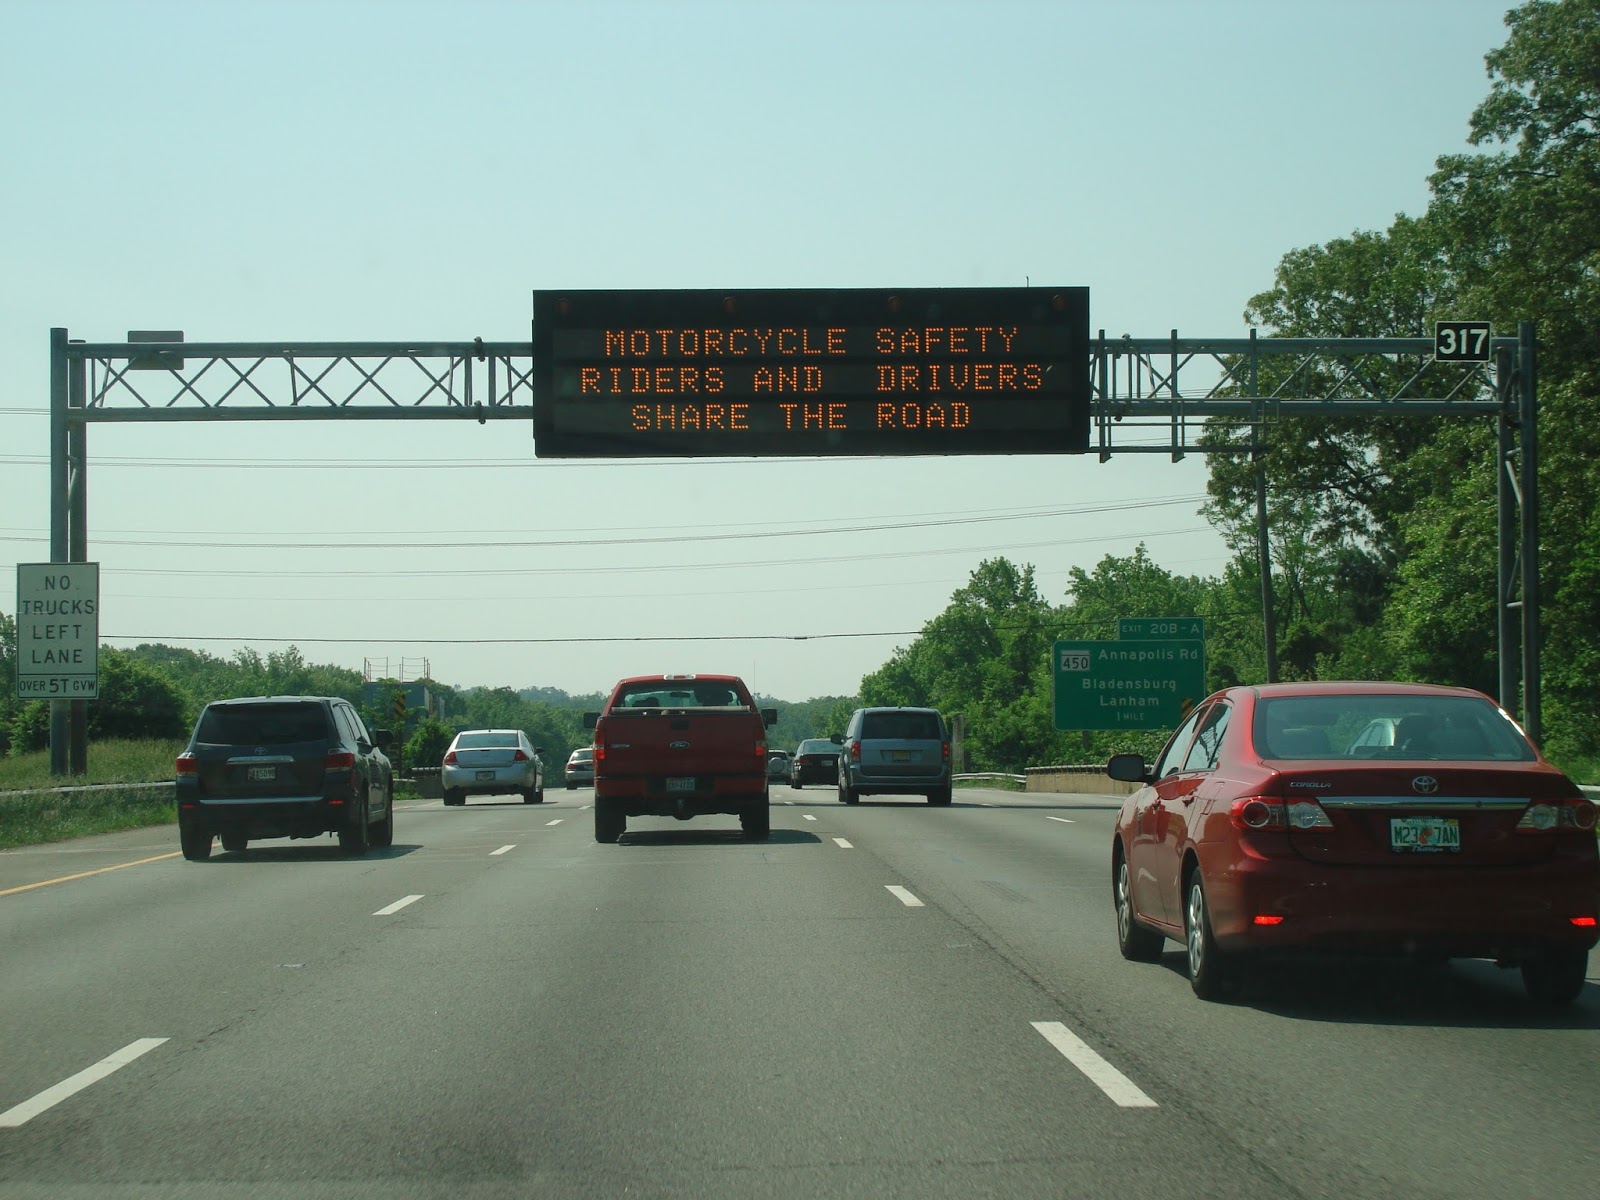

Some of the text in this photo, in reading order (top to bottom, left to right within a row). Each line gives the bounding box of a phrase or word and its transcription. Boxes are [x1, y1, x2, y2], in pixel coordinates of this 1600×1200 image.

[606, 327, 1017, 356] MOTORCYCLE SAFETY
[1439, 328, 1488, 355] 317
[581, 364, 1041, 393] RIDERS AND DRIVERS
[632, 402, 969, 430] SHARE THE ROAD
[45, 575, 70, 590] NO
[22, 600, 94, 615] TRUCKS
[32, 625, 82, 640] LEFT
[1121, 624, 1142, 633] EXIT
[32, 649, 83, 664] LANE
[1098, 649, 1198, 662] Annapolis Rd
[1062, 657, 1089, 669] 450
[20, 679, 96, 693] OVER 5T GVW
[1082, 678, 1176, 692] Bladensburg
[1100, 695, 1160, 707] Lanham
[1123, 713, 1145, 721] MILE
[1289, 781, 1332, 789] COROLLA
